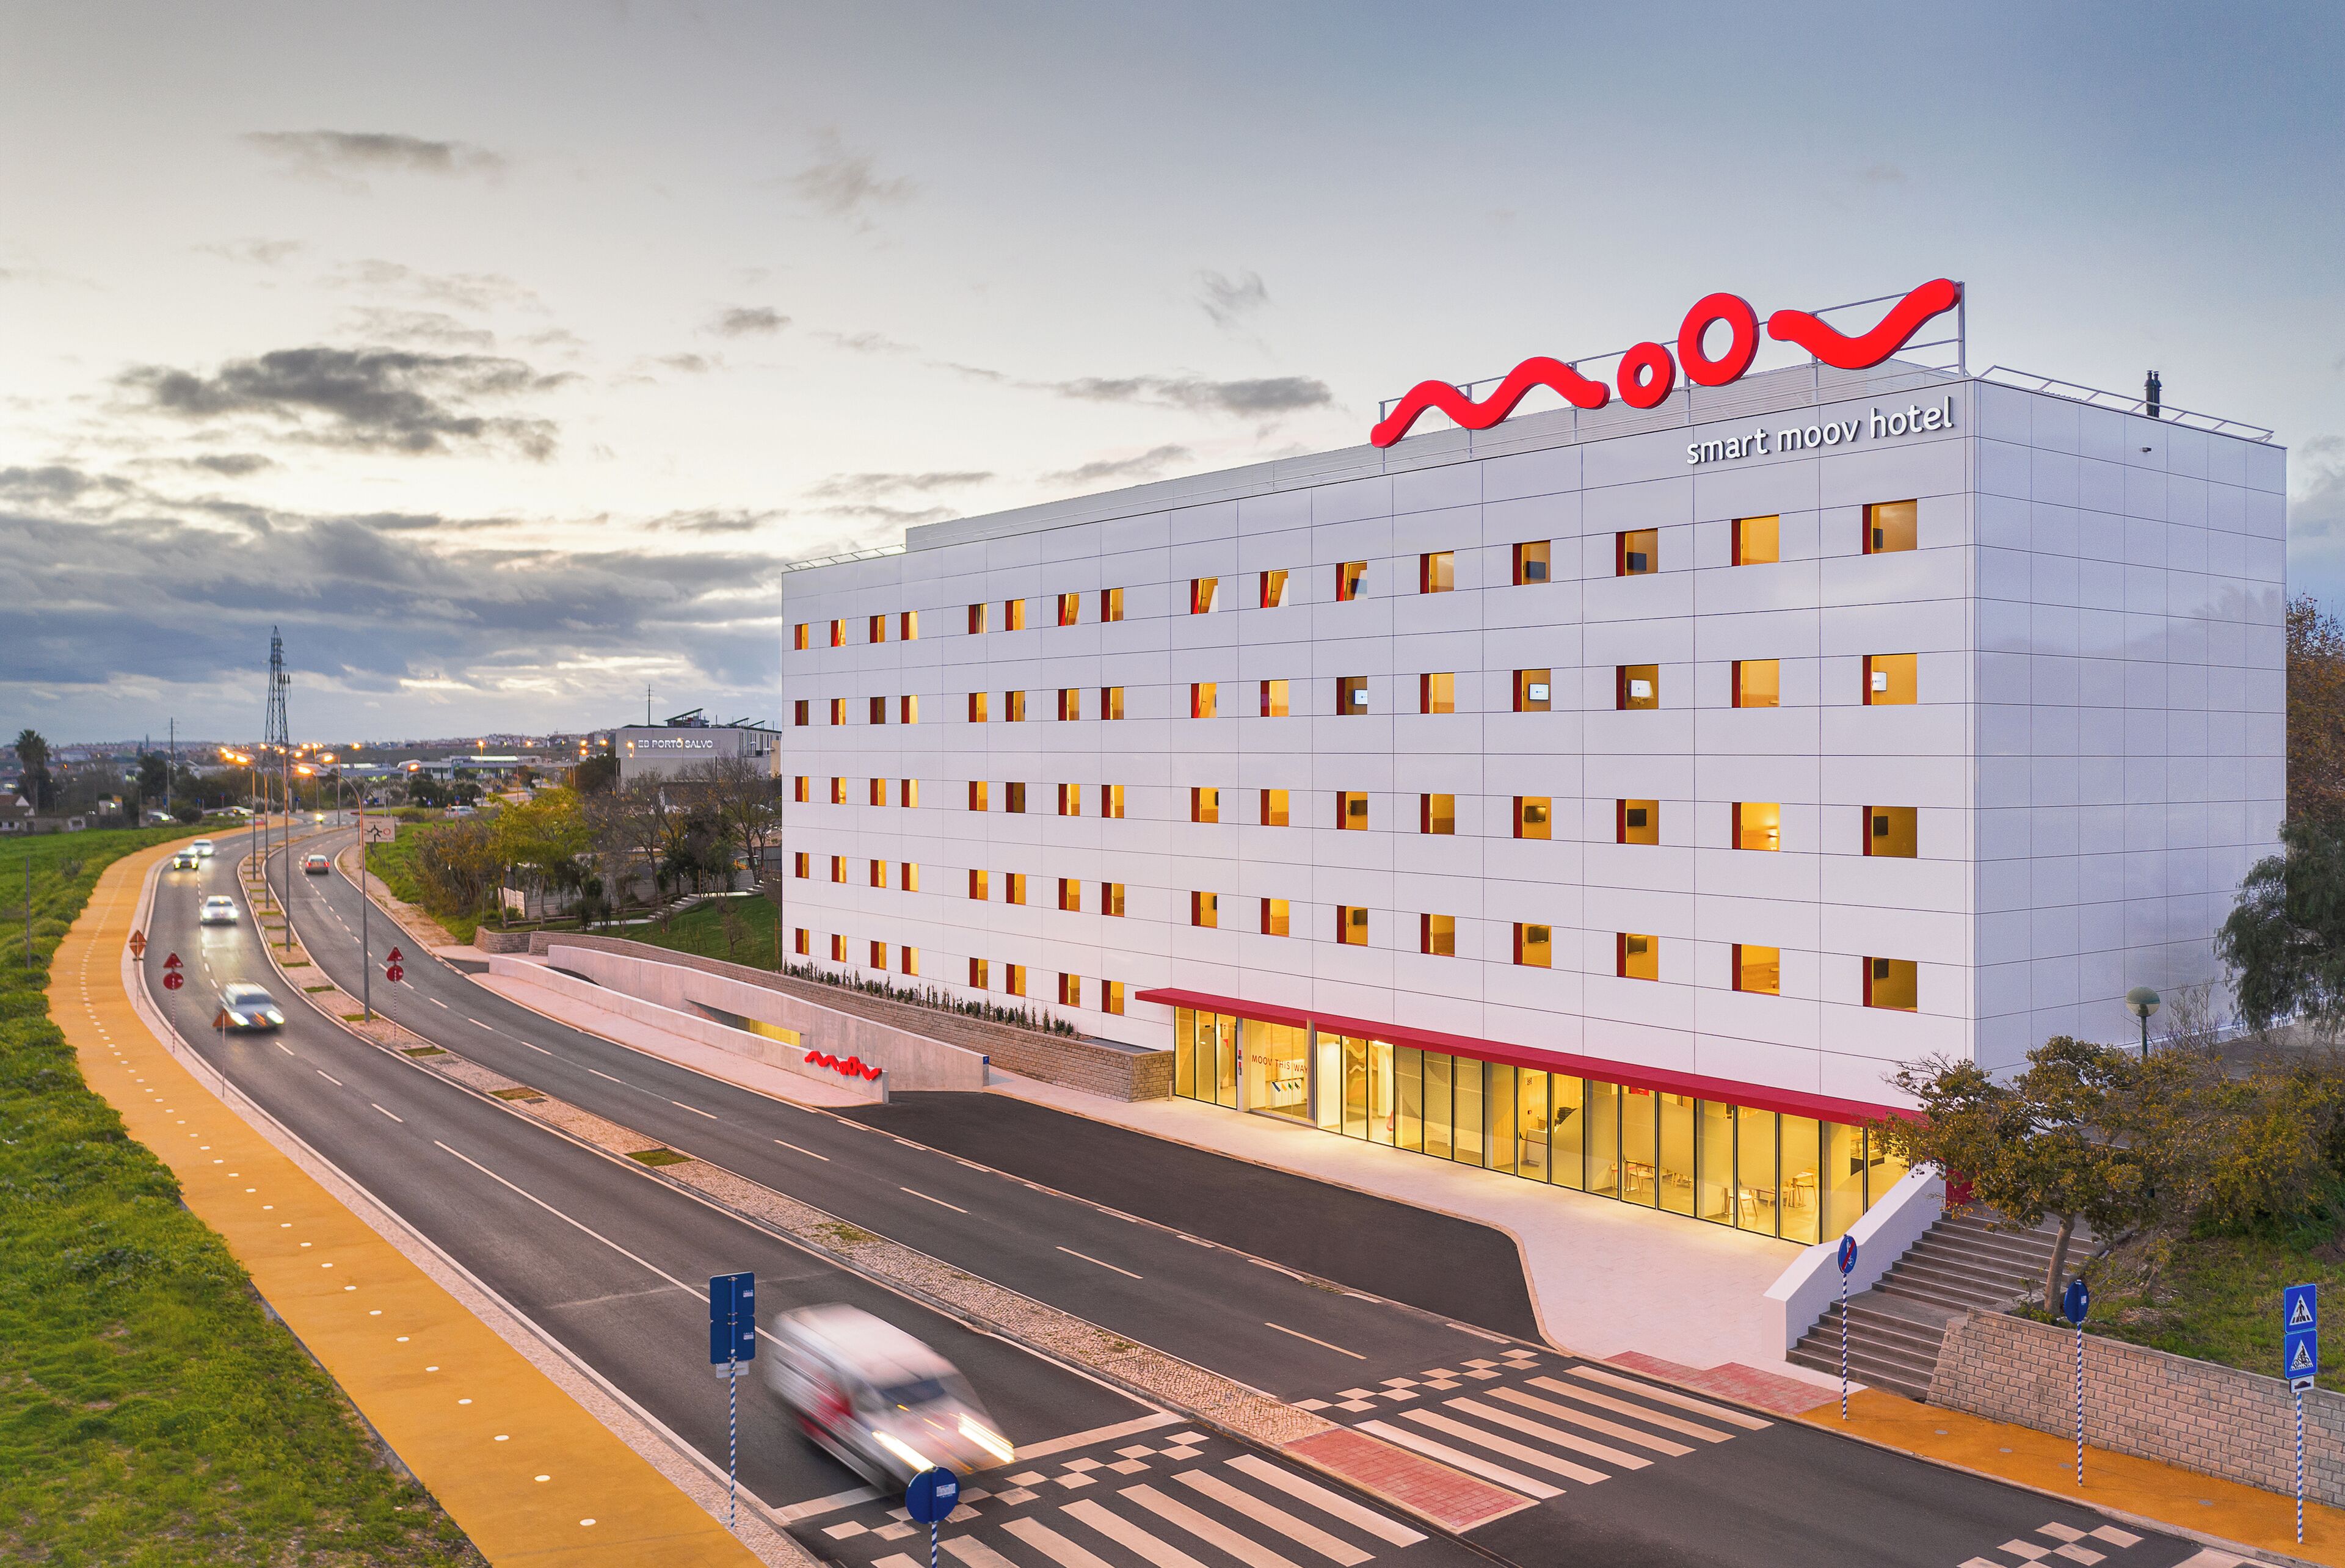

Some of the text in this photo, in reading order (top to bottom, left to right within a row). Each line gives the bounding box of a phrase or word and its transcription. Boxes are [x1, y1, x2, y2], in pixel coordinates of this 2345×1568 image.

[1686, 395, 1954, 465] smart moov hotel
[638, 739, 713, 749] EB PORTO SALVO
[1251, 1054, 1308, 1074] MOOV THIS WAY
